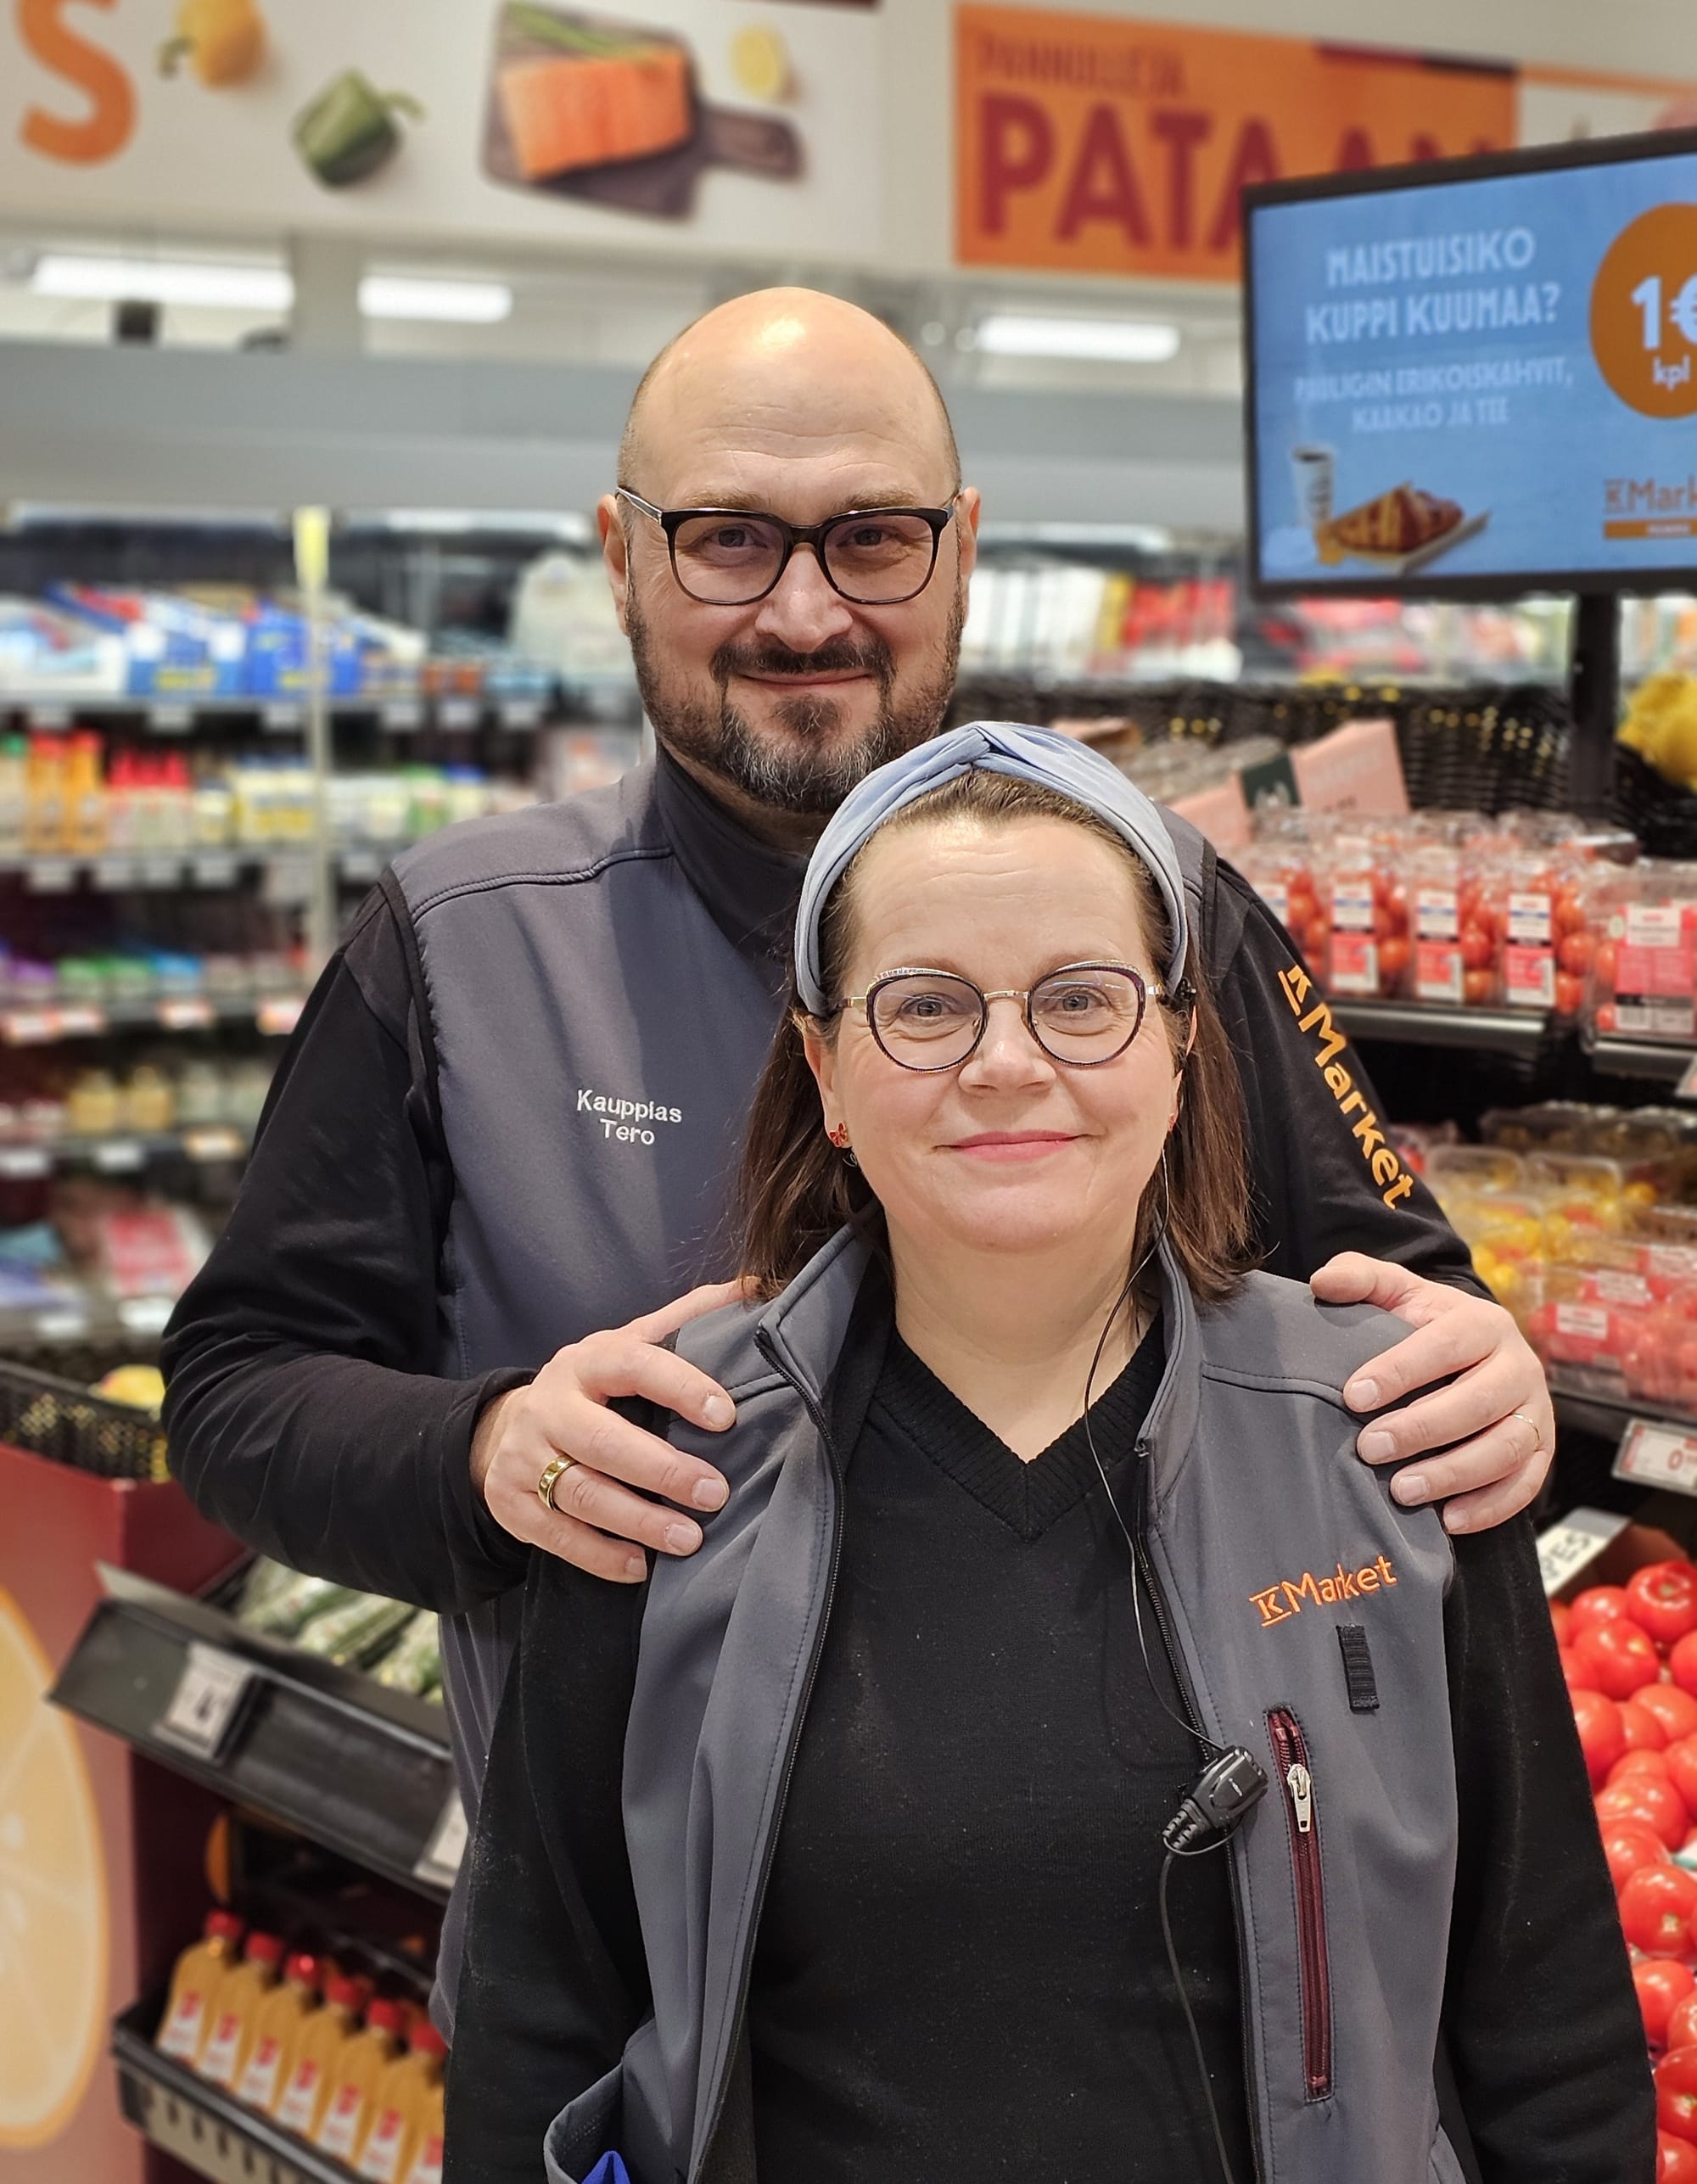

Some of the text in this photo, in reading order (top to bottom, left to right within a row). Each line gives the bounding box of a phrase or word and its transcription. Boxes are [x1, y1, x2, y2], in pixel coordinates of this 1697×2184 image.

[1326, 226, 1537, 288] MAISTUISIKO
[1305, 281, 1561, 344] KUPPI KUUMAA?
[1652, 354, 1690, 391] kpl
[576, 1089, 682, 1123] Kauppias
[599, 1117, 655, 1145] Tero
